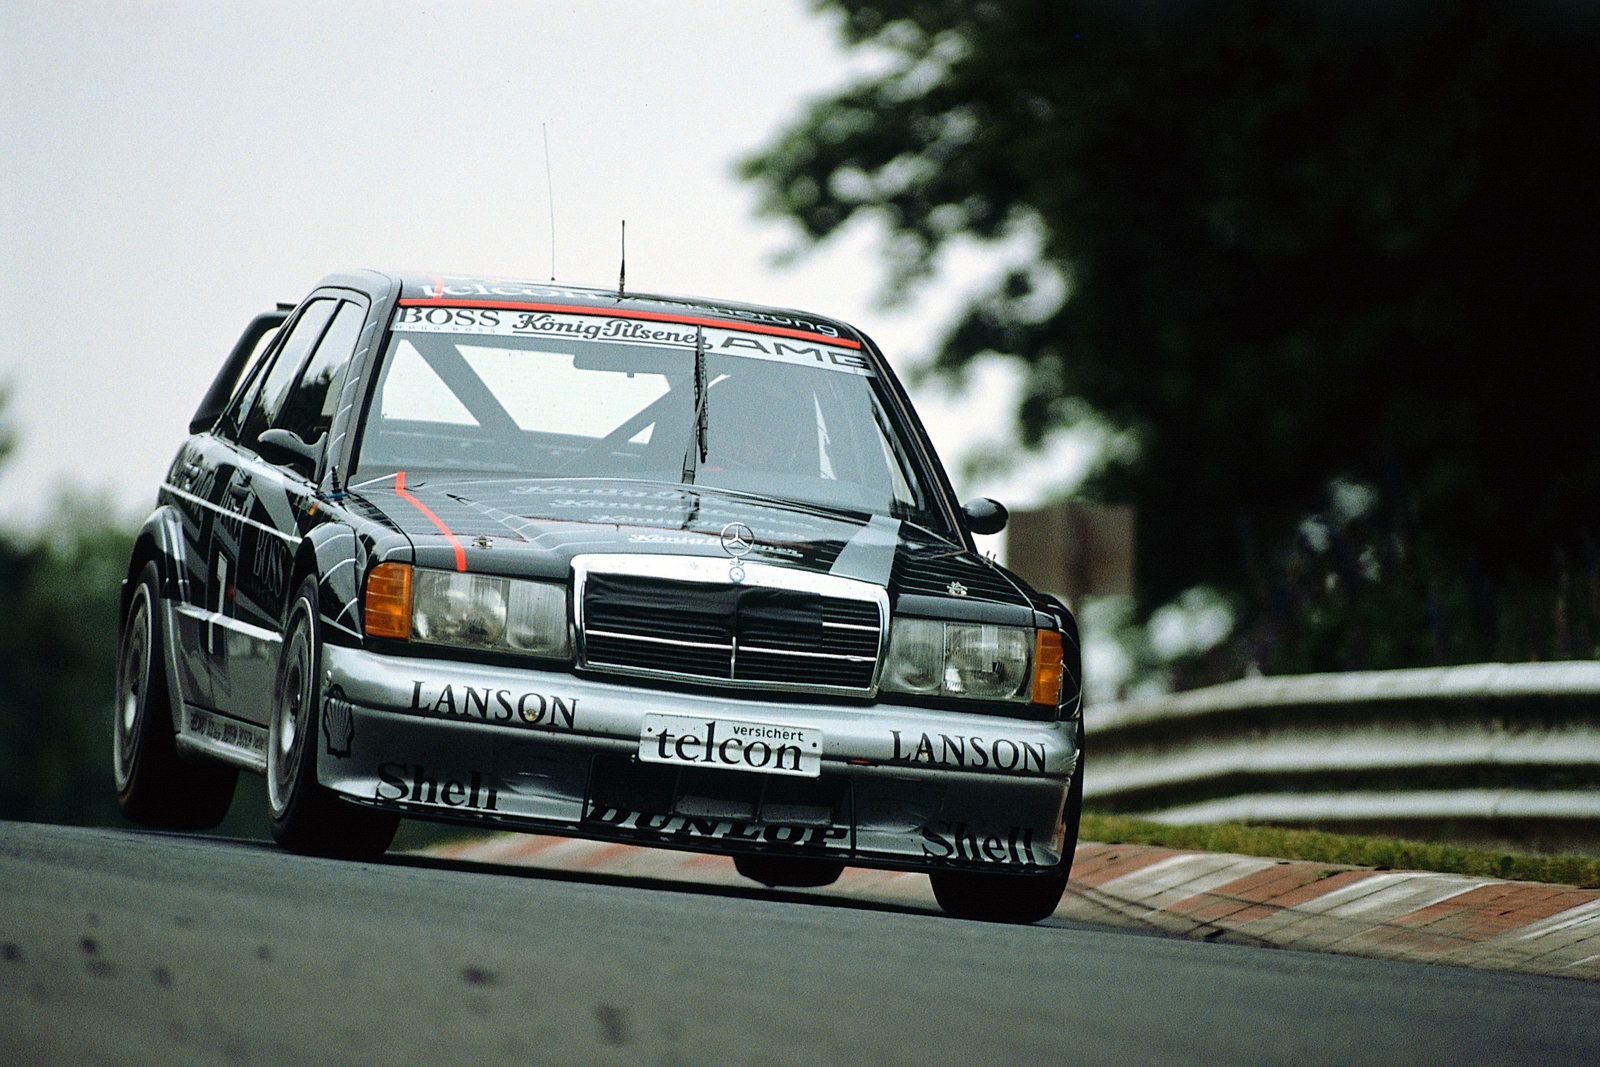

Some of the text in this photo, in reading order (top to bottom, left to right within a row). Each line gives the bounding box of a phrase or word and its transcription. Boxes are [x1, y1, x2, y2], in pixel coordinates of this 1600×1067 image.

[399, 307, 500, 327] BOSS
[720, 336, 871, 370] AMG
[408, 680, 580, 729] LANSON
[656, 721, 804, 772] telcon
[733, 726, 804, 742] versichert
[889, 730, 1046, 774] LANSON
[375, 762, 501, 811] Shell
[585, 804, 848, 846] DUNLOP
[922, 821, 1037, 865] Shell
